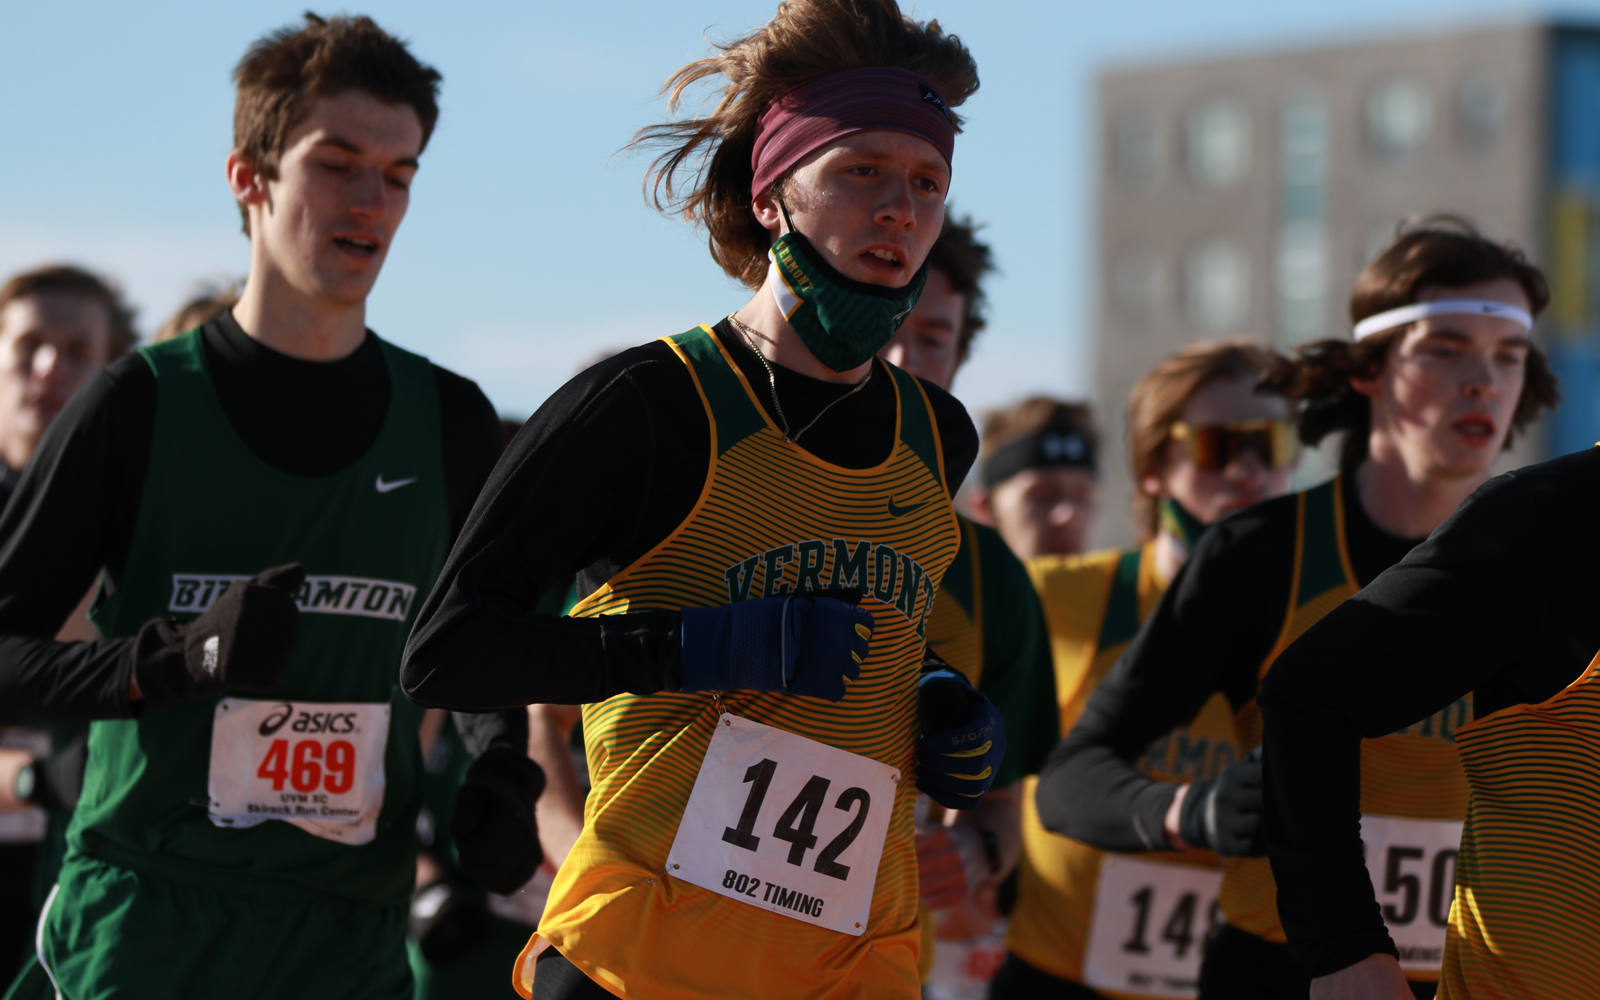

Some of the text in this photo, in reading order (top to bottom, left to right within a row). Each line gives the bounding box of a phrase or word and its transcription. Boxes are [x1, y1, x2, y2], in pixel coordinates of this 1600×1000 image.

[776, 241, 814, 293] VERMONT
[174, 579, 412, 615] BIAMTON
[724, 538, 934, 639] VERMONT
[257, 739, 356, 794] 469
[247, 804, 360, 818] Skirack Run Center
[280, 794, 328, 805] UVM XC
[721, 758, 871, 882] 142
[722, 869, 761, 898] 802
[763, 881, 825, 918] TIMING
[1364, 844, 1459, 928] 50
